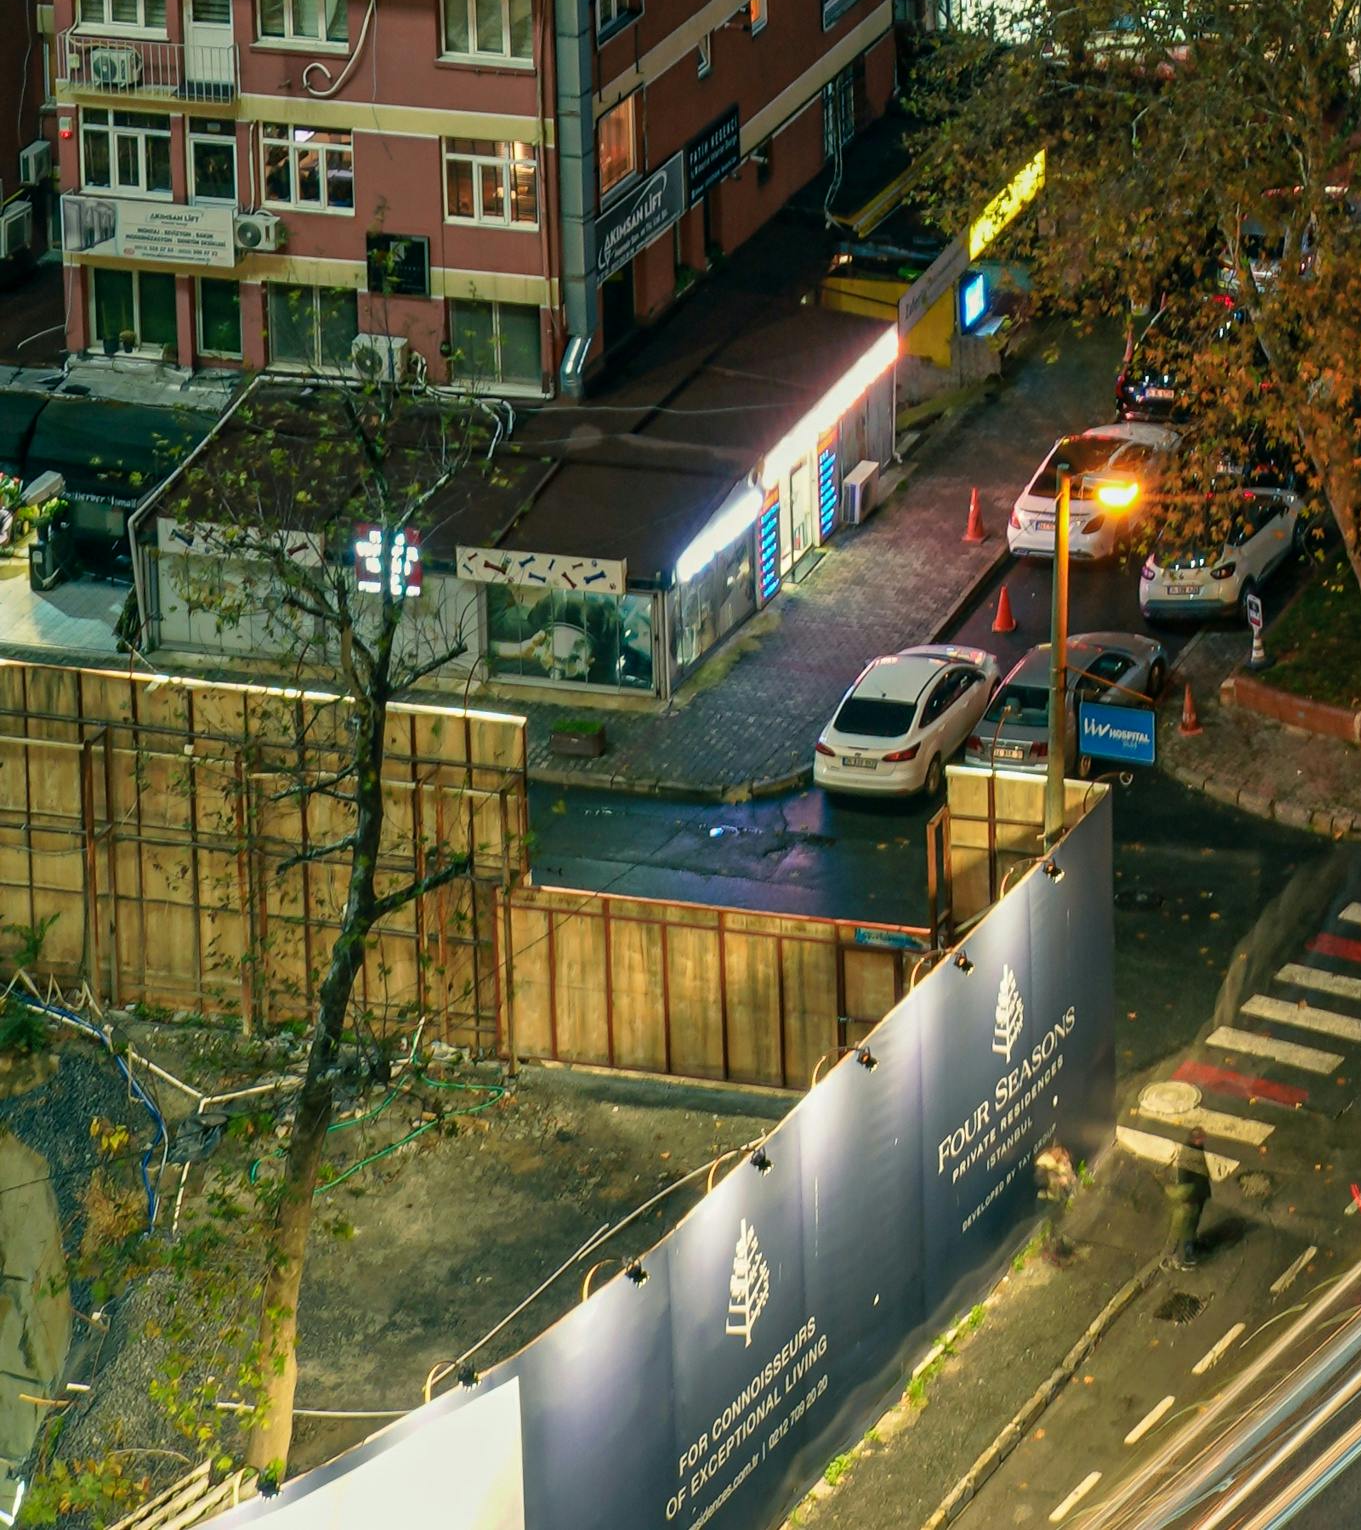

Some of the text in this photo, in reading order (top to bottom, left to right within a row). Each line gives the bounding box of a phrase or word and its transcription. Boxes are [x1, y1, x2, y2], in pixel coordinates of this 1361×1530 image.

[1109, 728, 1151, 745] HOSPITAL
[937, 1005, 1076, 1176] FOUR SEASONS
[952, 1054, 1065, 1185] PRIVATE RESIDENCES
[961, 1180, 1005, 1233] DEVELOPED
[1006, 1171, 1017, 1186] BY
[1018, 1154, 1032, 1171] TAY
[986, 1115, 1033, 1172] ISTANBUL
[665, 1334, 828, 1520] OF EXCEPTIONAL LIVING
[678, 1315, 817, 1478] FOR CONNOISSEURS
[768, 1416, 789, 1451] 0212
[805, 1386, 817, 1410] 20
[817, 1374, 829, 1397] 20
